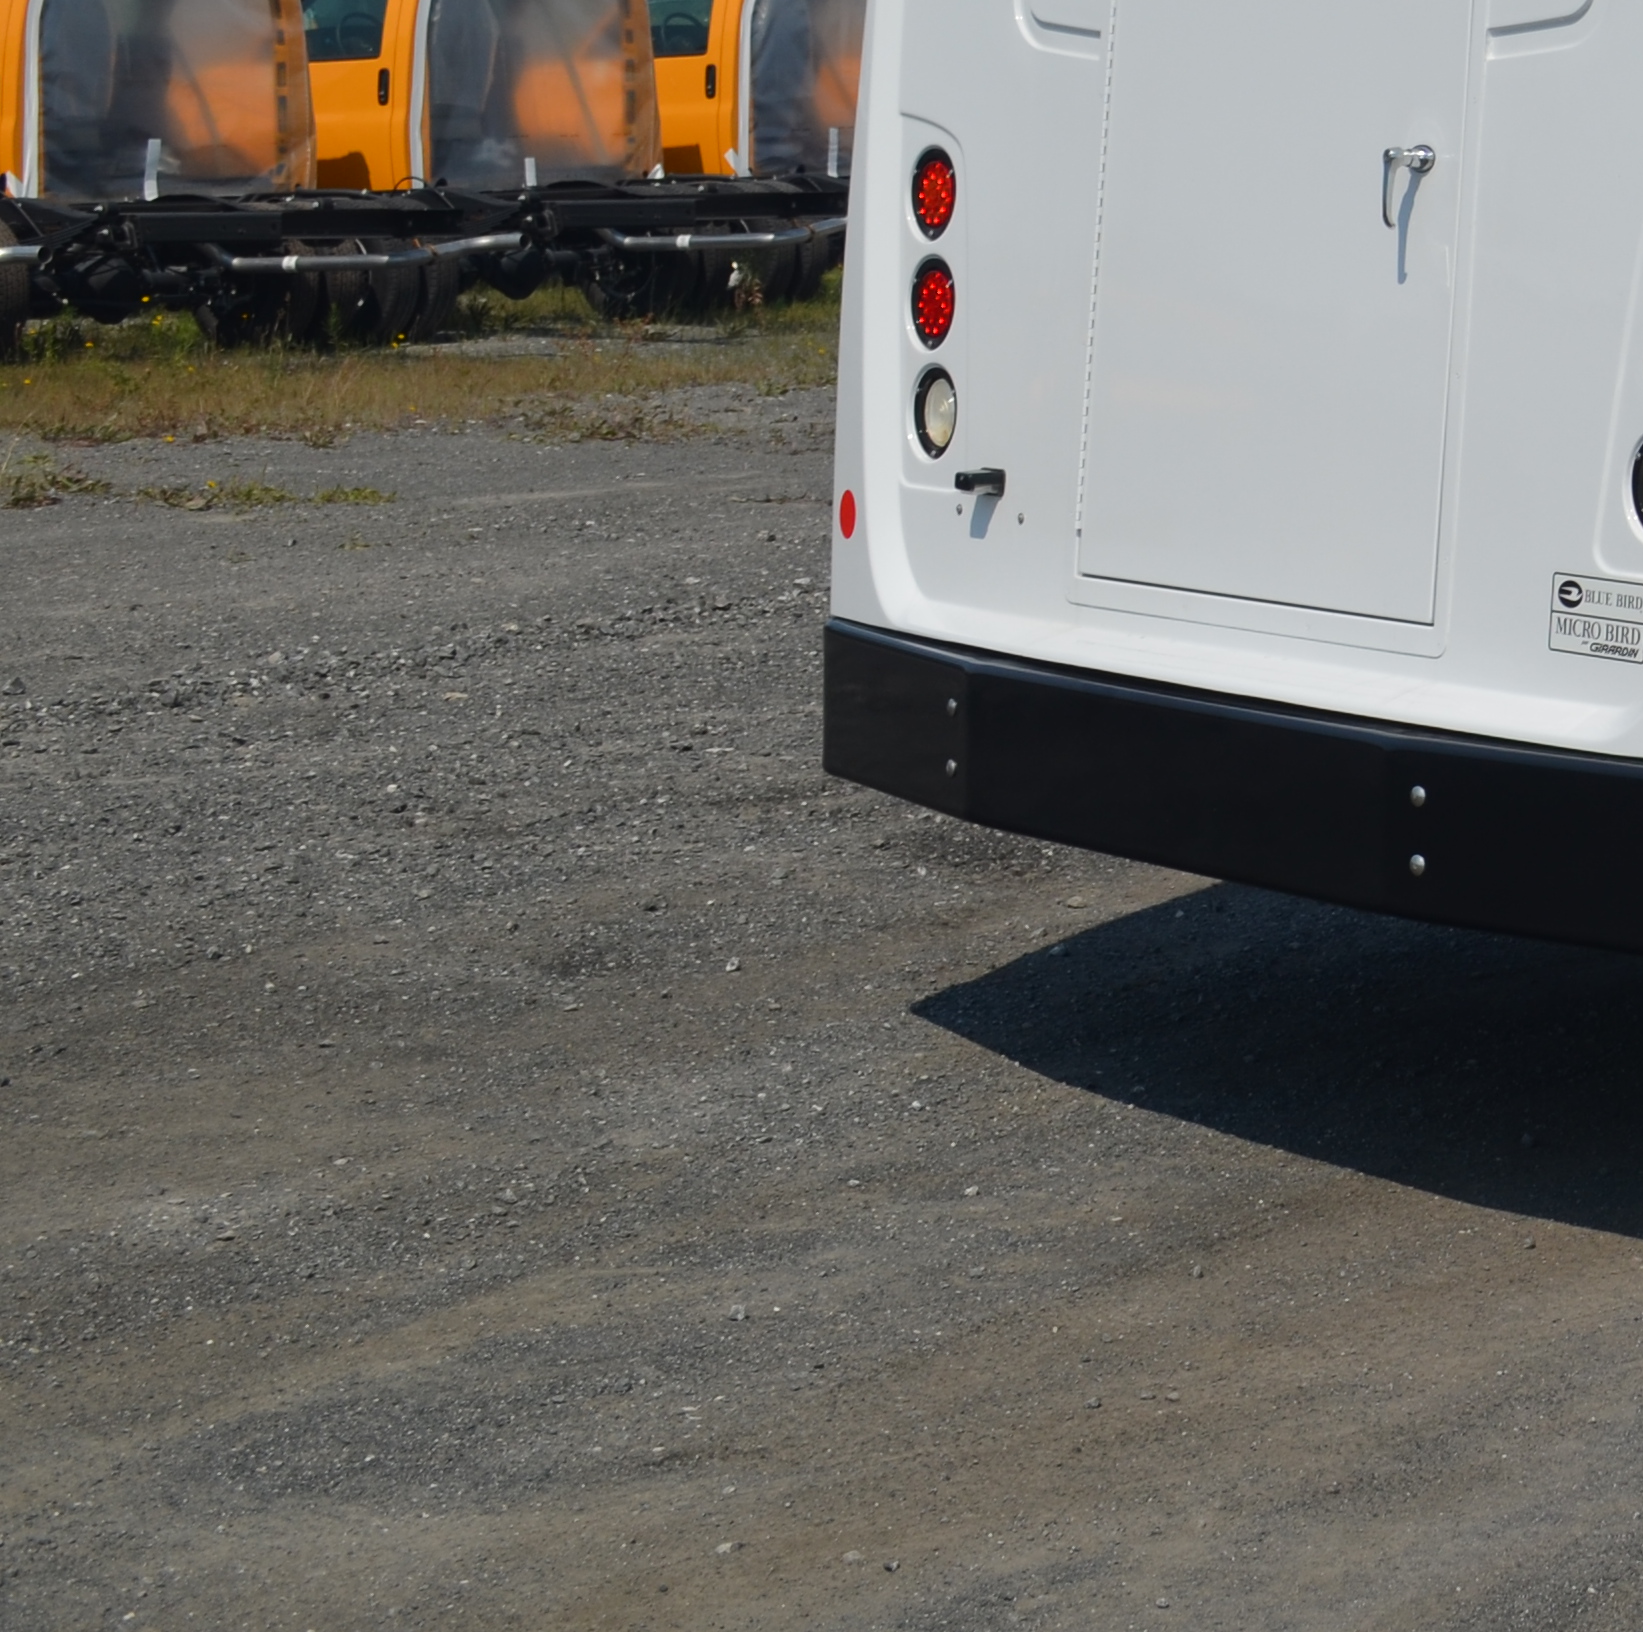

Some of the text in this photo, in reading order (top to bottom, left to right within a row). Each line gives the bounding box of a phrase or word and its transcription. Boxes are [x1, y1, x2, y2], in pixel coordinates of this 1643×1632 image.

[1584, 589, 1643, 610] BLUE BIRD
[1555, 616, 1641, 646] MICRO BIRD
[1590, 642, 1639, 659] GIRARDIN
